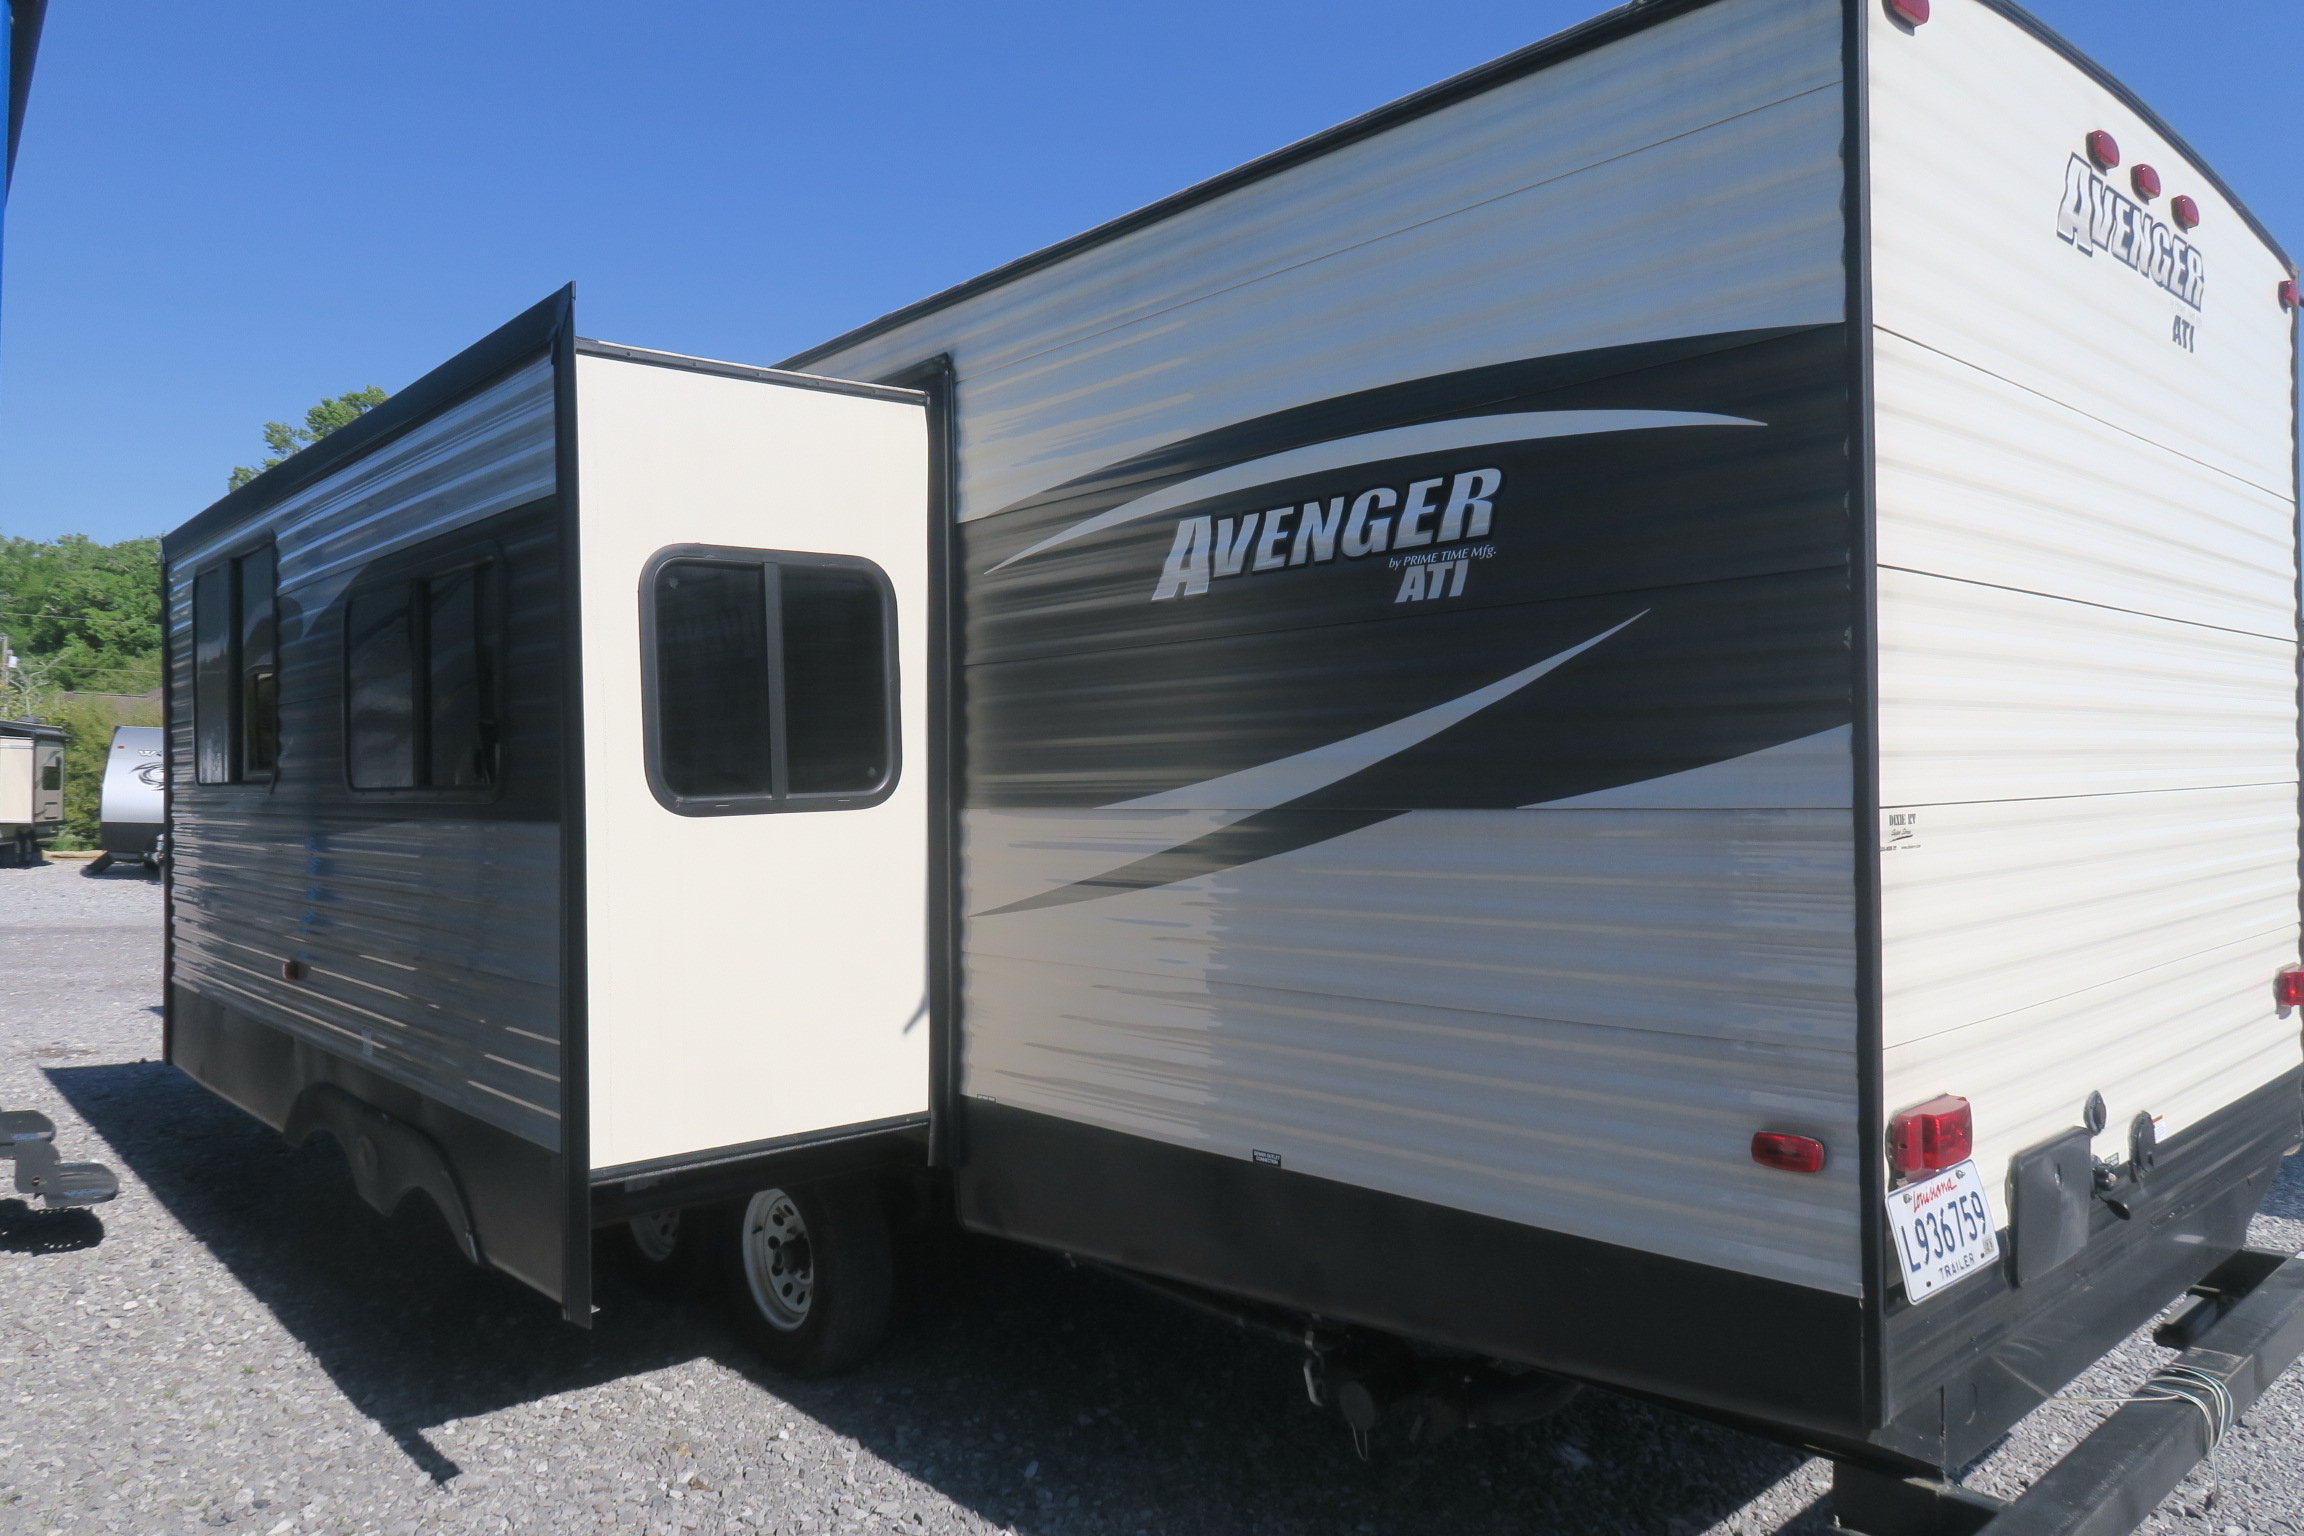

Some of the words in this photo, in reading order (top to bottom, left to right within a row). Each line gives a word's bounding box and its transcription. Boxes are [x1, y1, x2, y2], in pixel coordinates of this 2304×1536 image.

[2057, 151, 2204, 312] AVENGER
[2172, 315, 2195, 353] ATI
[1151, 468, 1502, 601] AVENGER
[1388, 557, 1402, 571] by
[1403, 552, 1438, 566] PRIME
[1441, 548, 1469, 561] TIME
[1470, 544, 1497, 559] Mfg.
[1394, 559, 1469, 603] ATI
[1913, 1177, 1957, 1213] Louisiana
[1901, 1191, 1986, 1273] L936759
[1939, 1252, 1976, 1280] TRAILER
